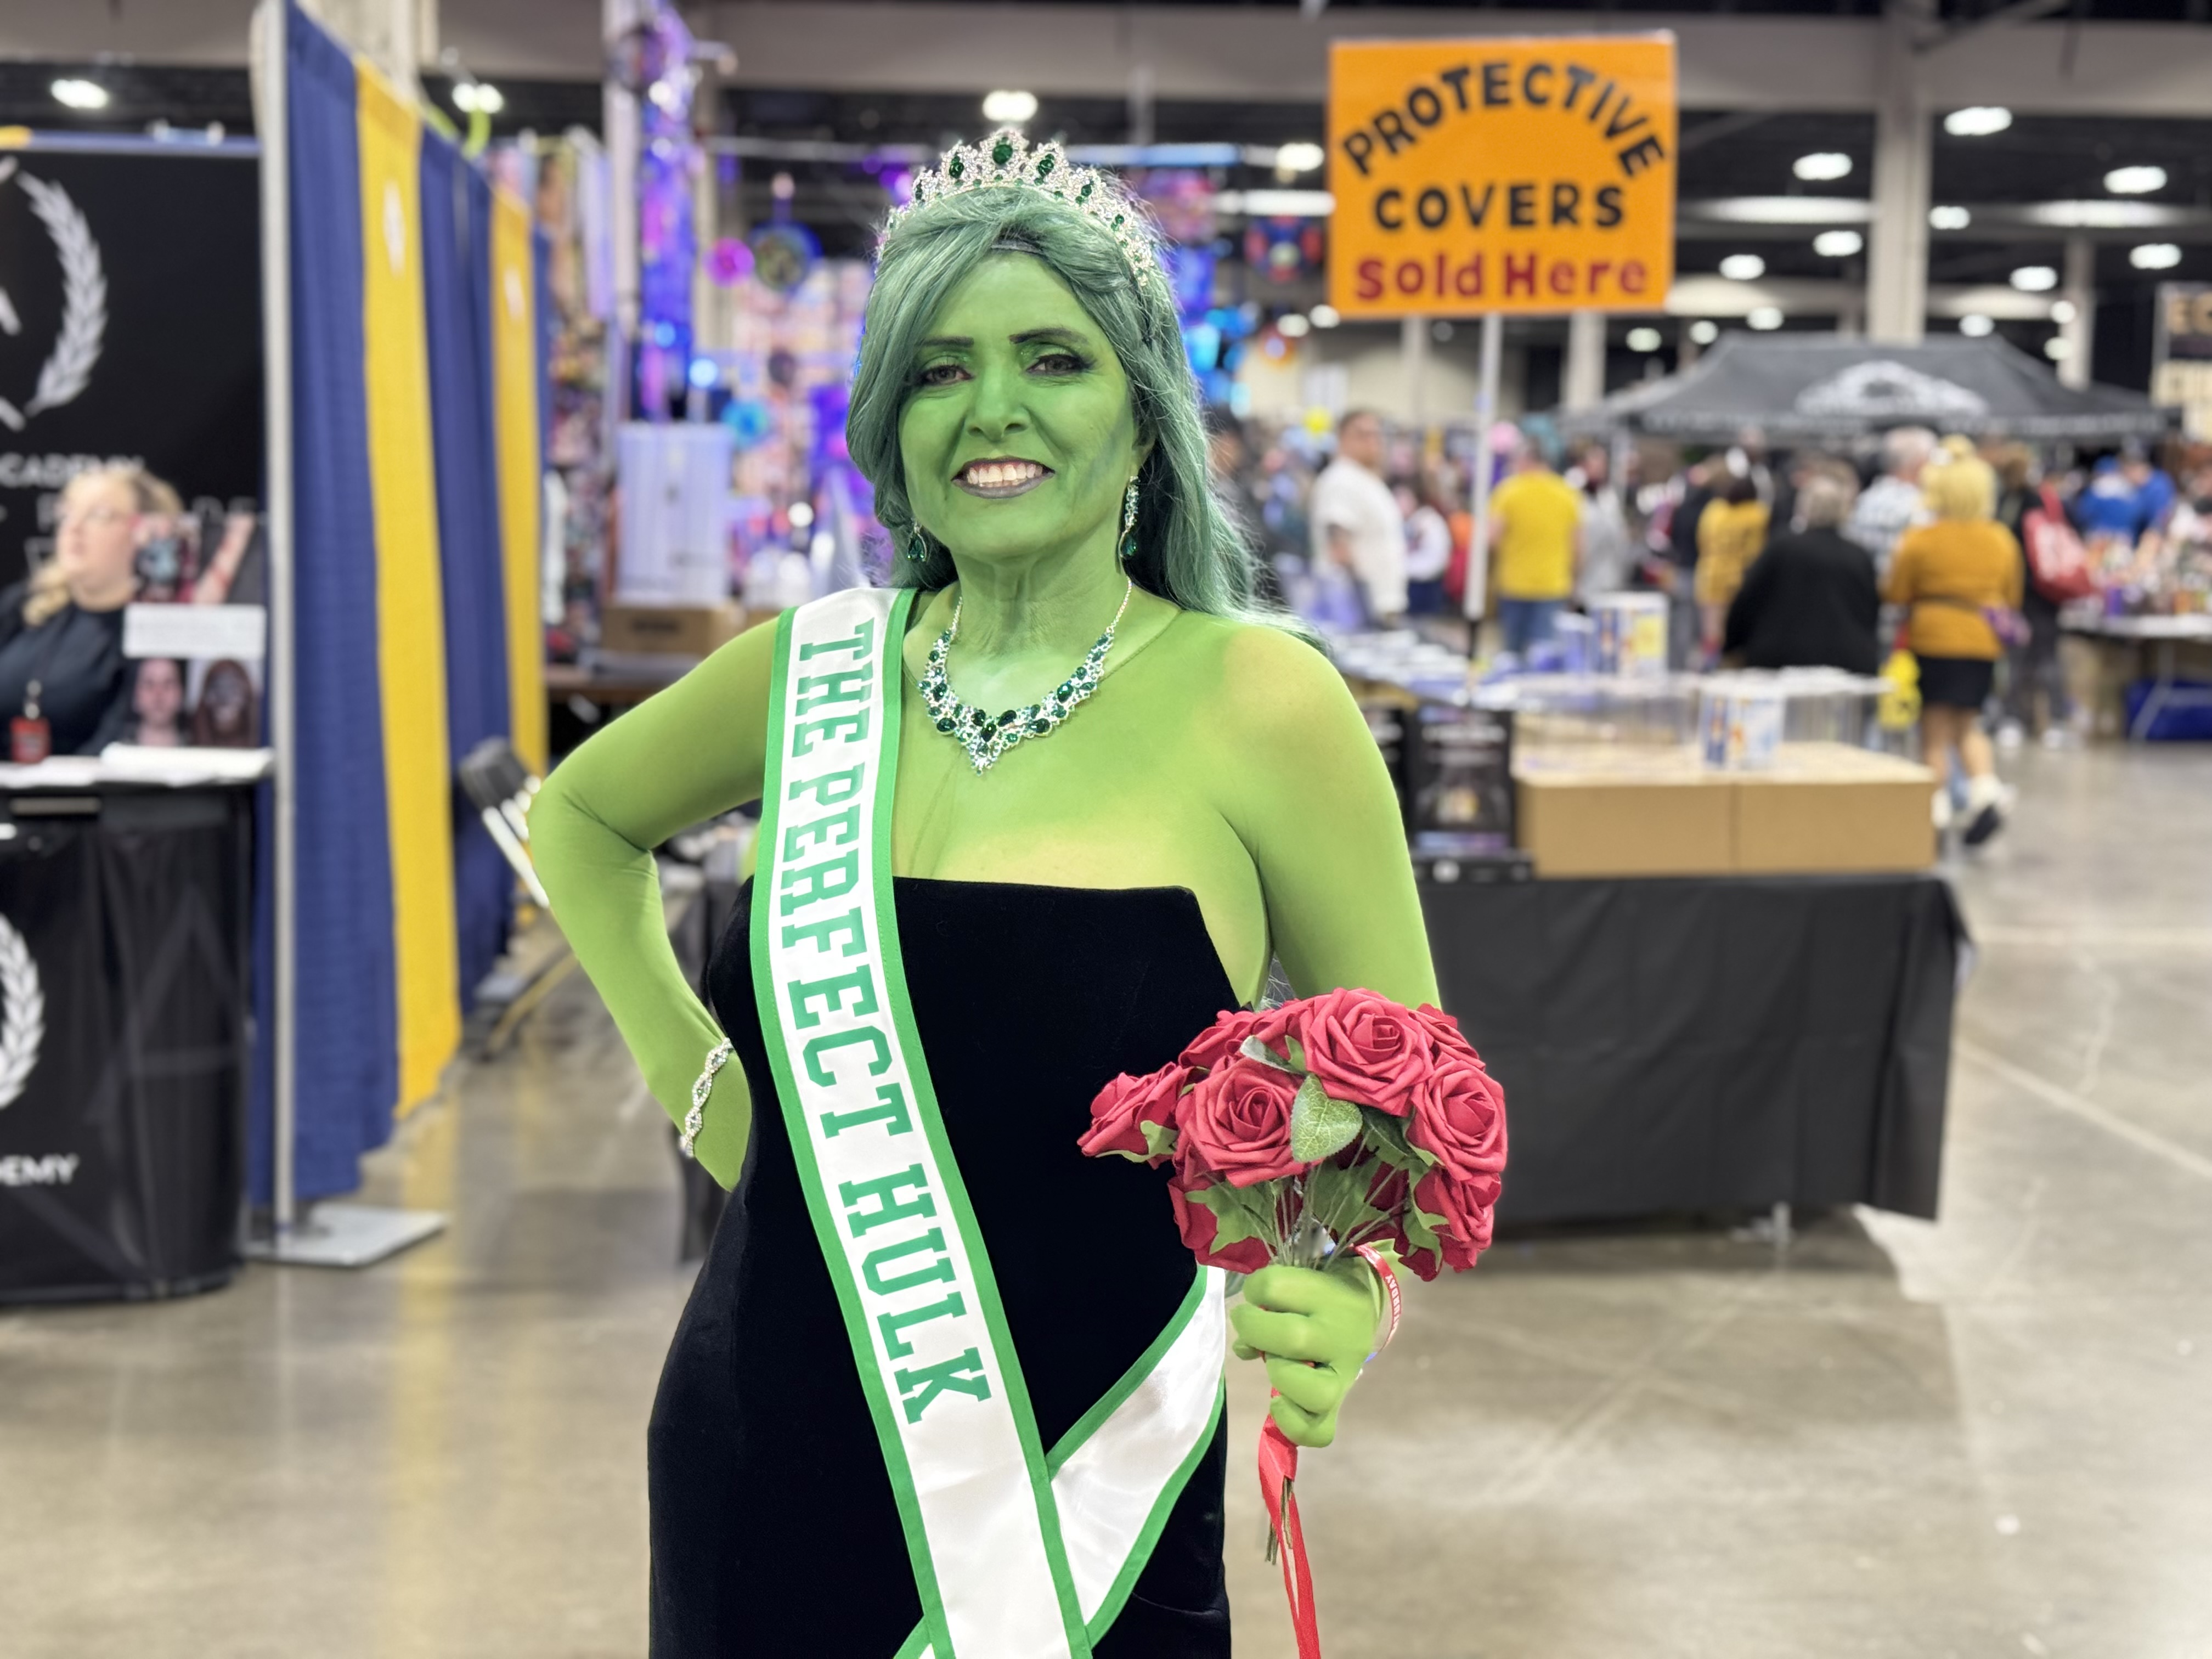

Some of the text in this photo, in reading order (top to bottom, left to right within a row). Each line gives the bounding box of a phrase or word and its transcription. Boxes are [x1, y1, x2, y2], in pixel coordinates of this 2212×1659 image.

[1342, 62, 1664, 178] PROTECTIVE
[1374, 182, 1624, 230] COVERS
[1505, 253, 1647, 296] Here
[780, 617, 992, 1425] THE PERFECT HULK
[0, 1153, 79, 1186] EMY
